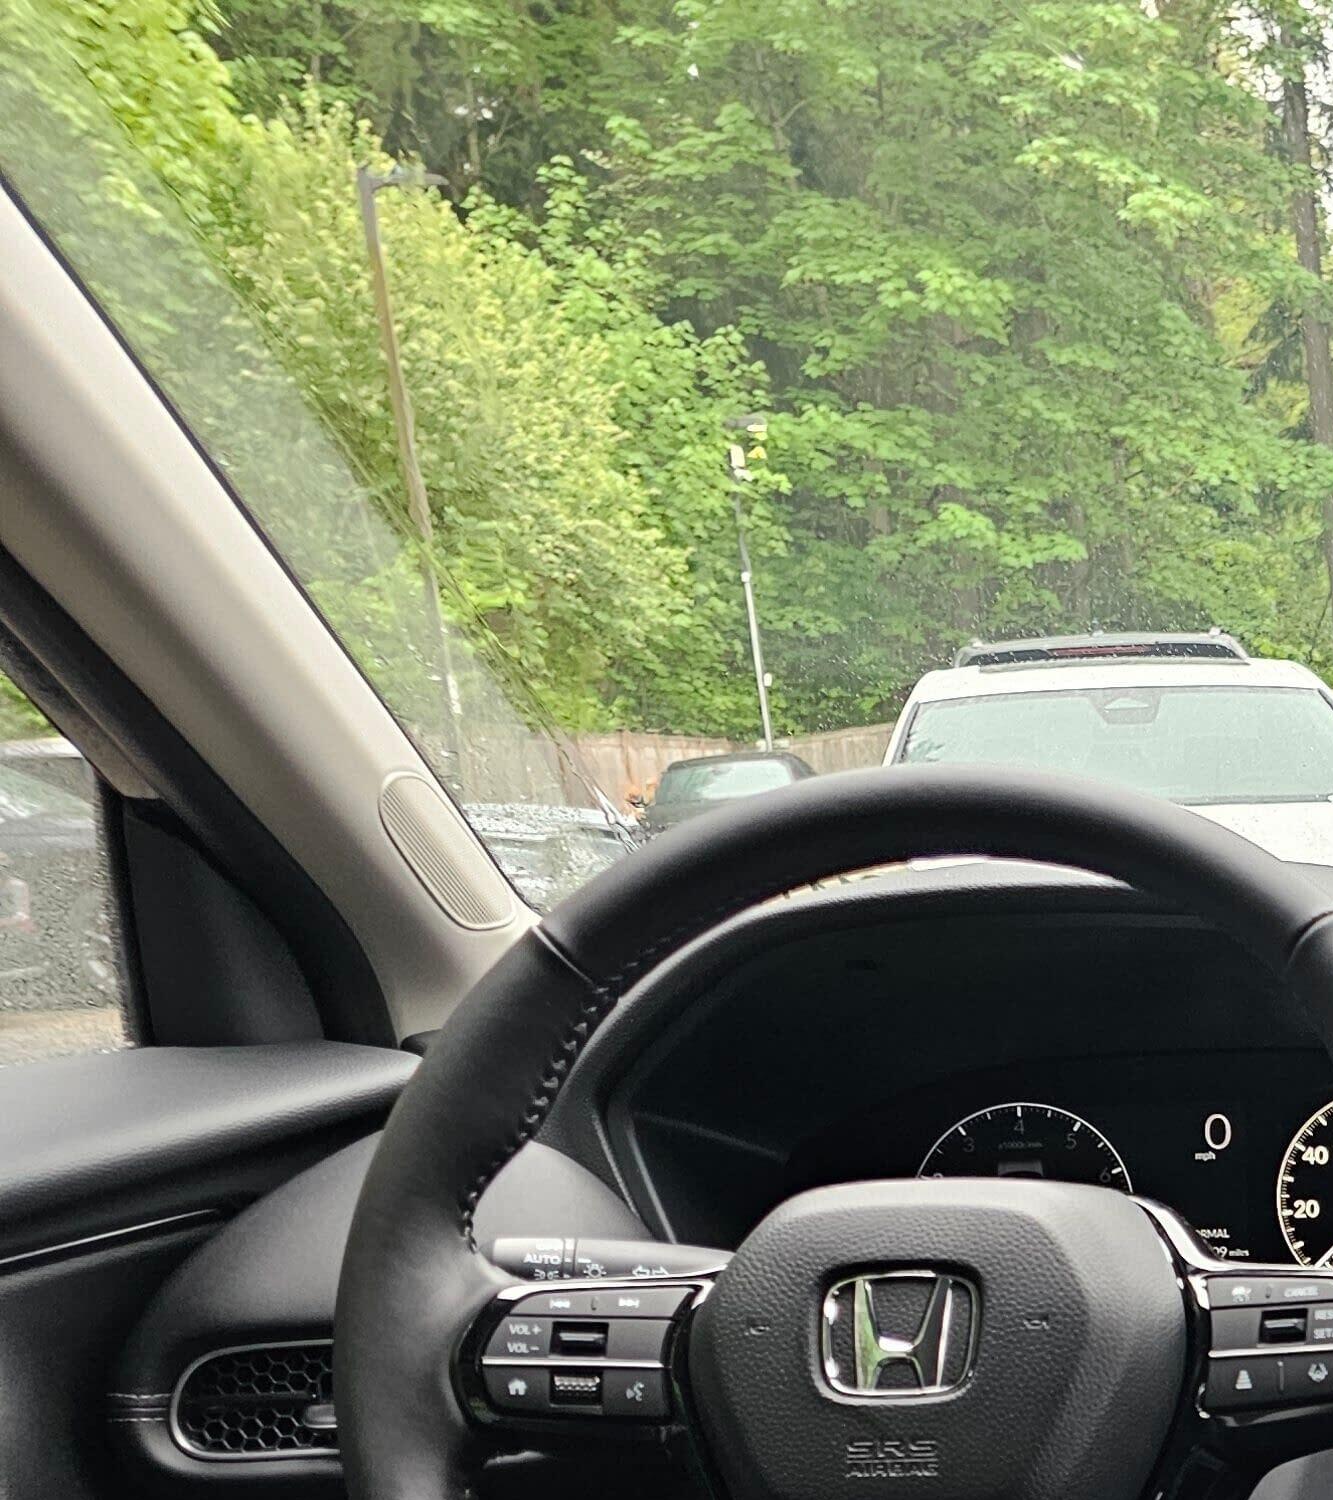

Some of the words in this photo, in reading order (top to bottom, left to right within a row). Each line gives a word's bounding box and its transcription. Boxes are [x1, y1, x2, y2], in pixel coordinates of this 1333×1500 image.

[1014, 1120, 1024, 1135] 4
[1204, 1114, 1232, 1150] 0
[963, 1138, 974, 1152] 3
[1066, 1134, 1077, 1149] 5
[1195, 1152, 1216, 1161] mph
[1302, 1146, 1329, 1166] 40
[1100, 1168, 1112, 1183] 6
[1294, 1200, 1320, 1218] 20
[524, 1253, 561, 1264] AUTO
[846, 1441, 937, 1458] SRS
[845, 1462, 939, 1478] AIRBAG
